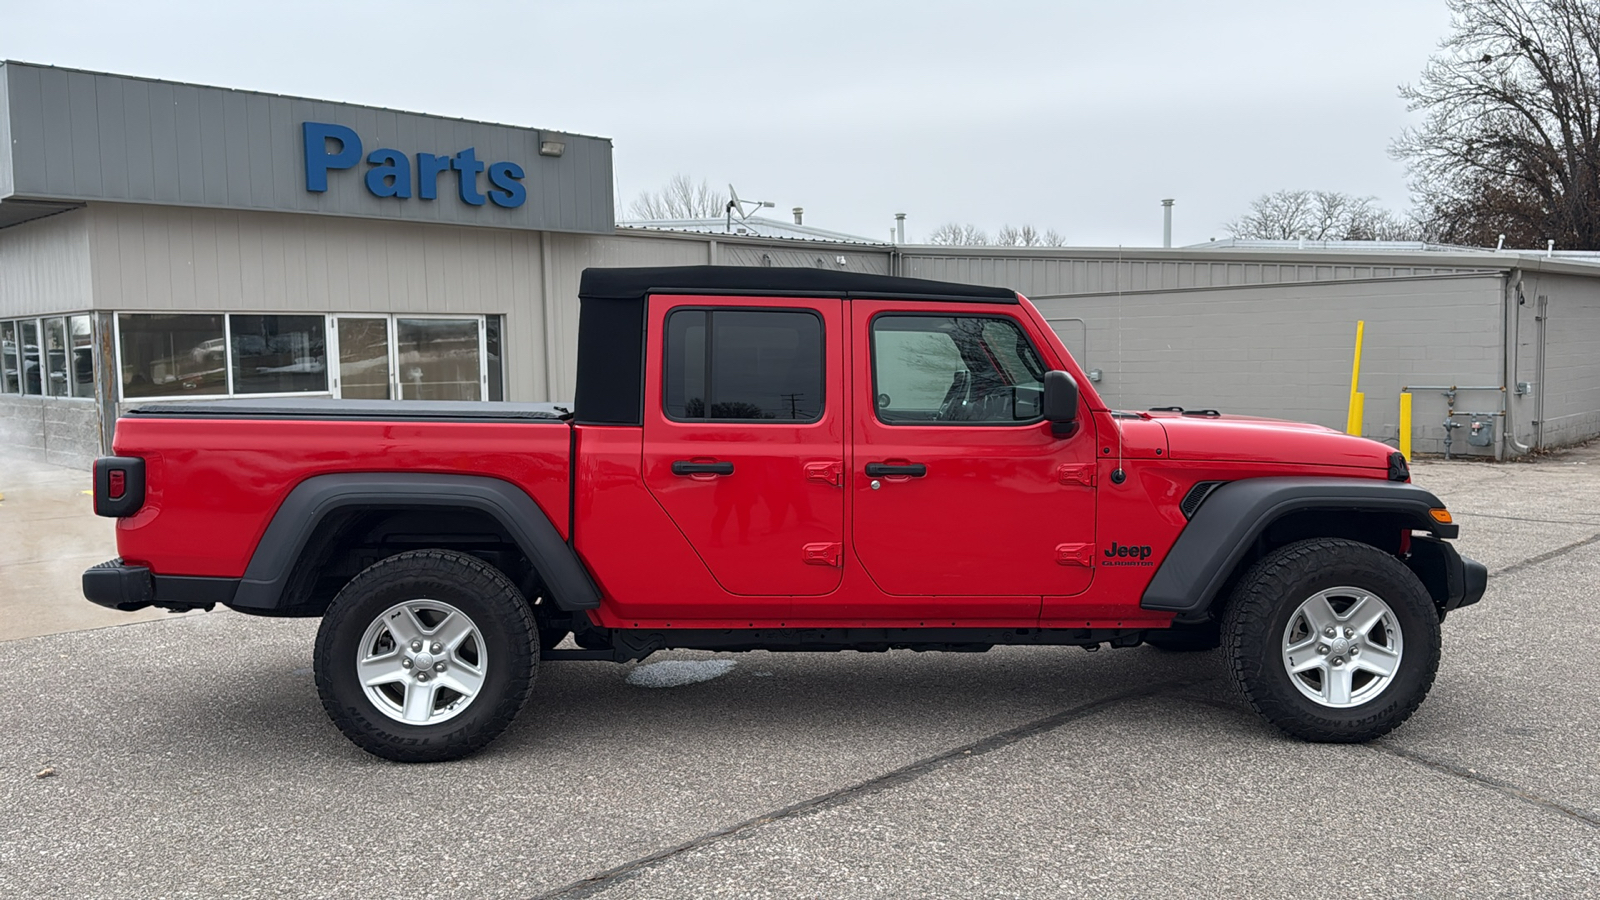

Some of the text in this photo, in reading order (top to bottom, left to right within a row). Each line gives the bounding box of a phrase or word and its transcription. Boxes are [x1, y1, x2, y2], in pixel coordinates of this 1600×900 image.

[302, 121, 527, 208] Parts
[1104, 541, 1152, 560] Jeep
[347, 706, 430, 746] TERRAIN
